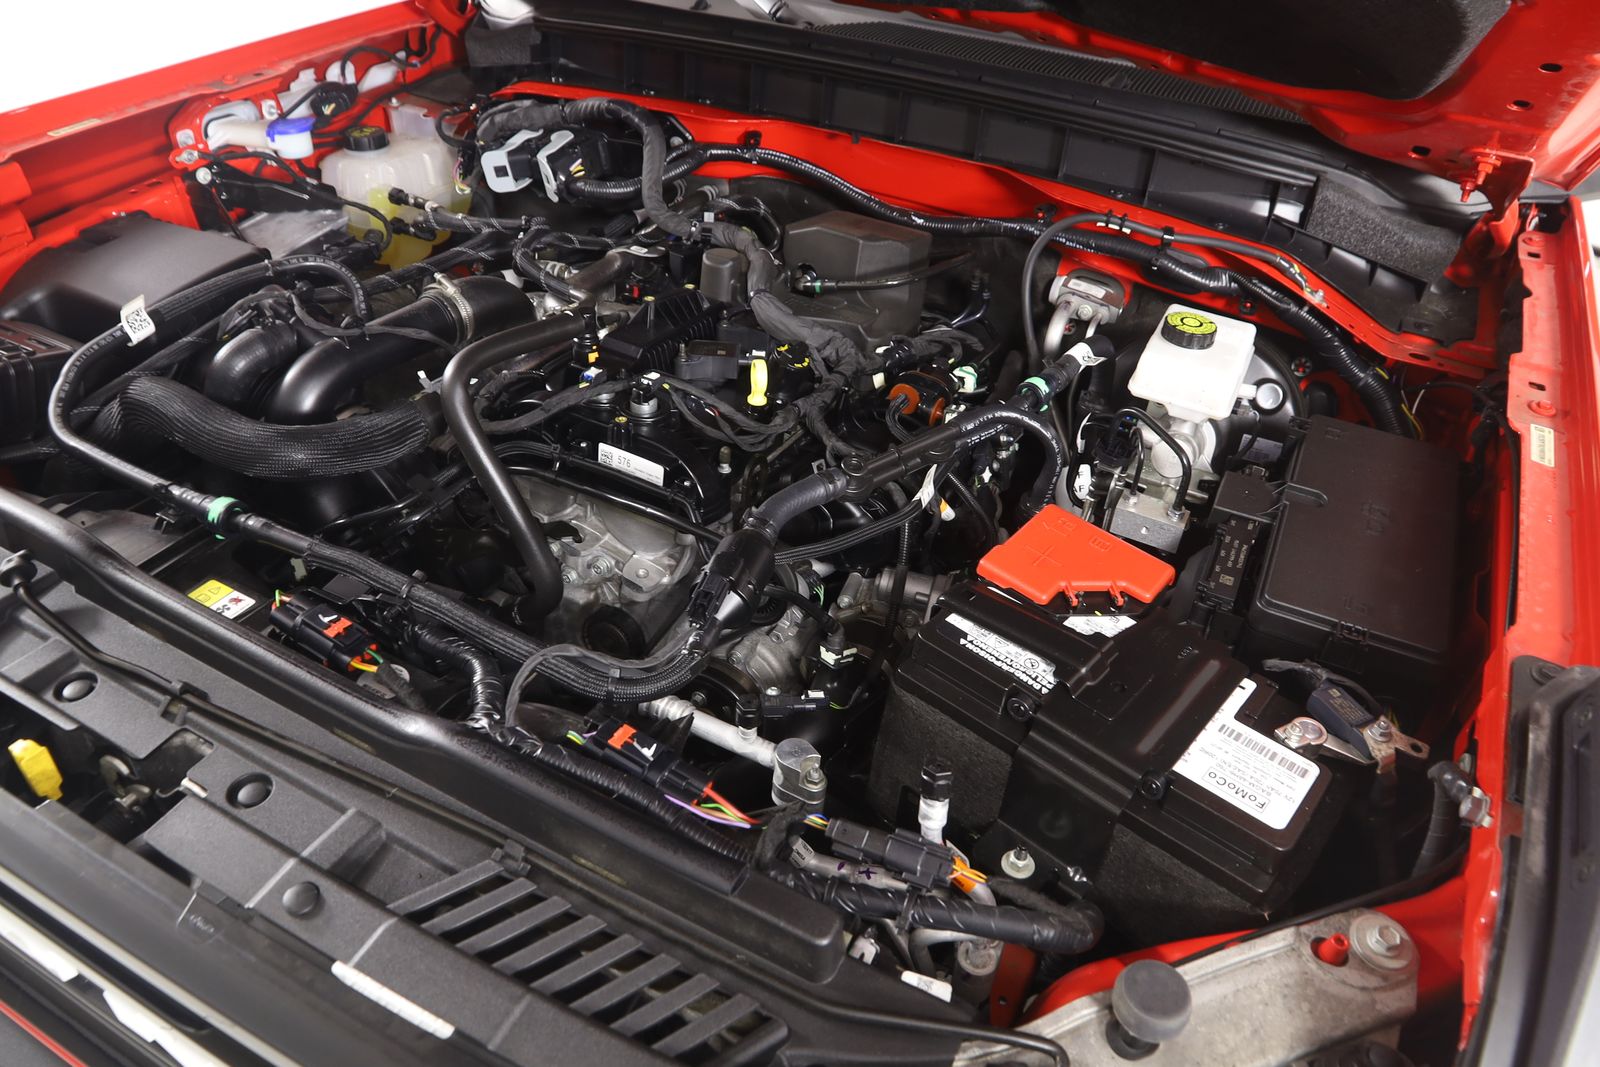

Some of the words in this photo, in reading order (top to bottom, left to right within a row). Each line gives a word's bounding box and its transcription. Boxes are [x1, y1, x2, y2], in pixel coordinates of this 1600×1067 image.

[617, 455, 631, 468] 576
[965, 643, 1042, 690] DANGER/POISON
[972, 639, 1056, 690] PELIGRO/VENENO
[1208, 771, 1266, 809] FoMoCo
